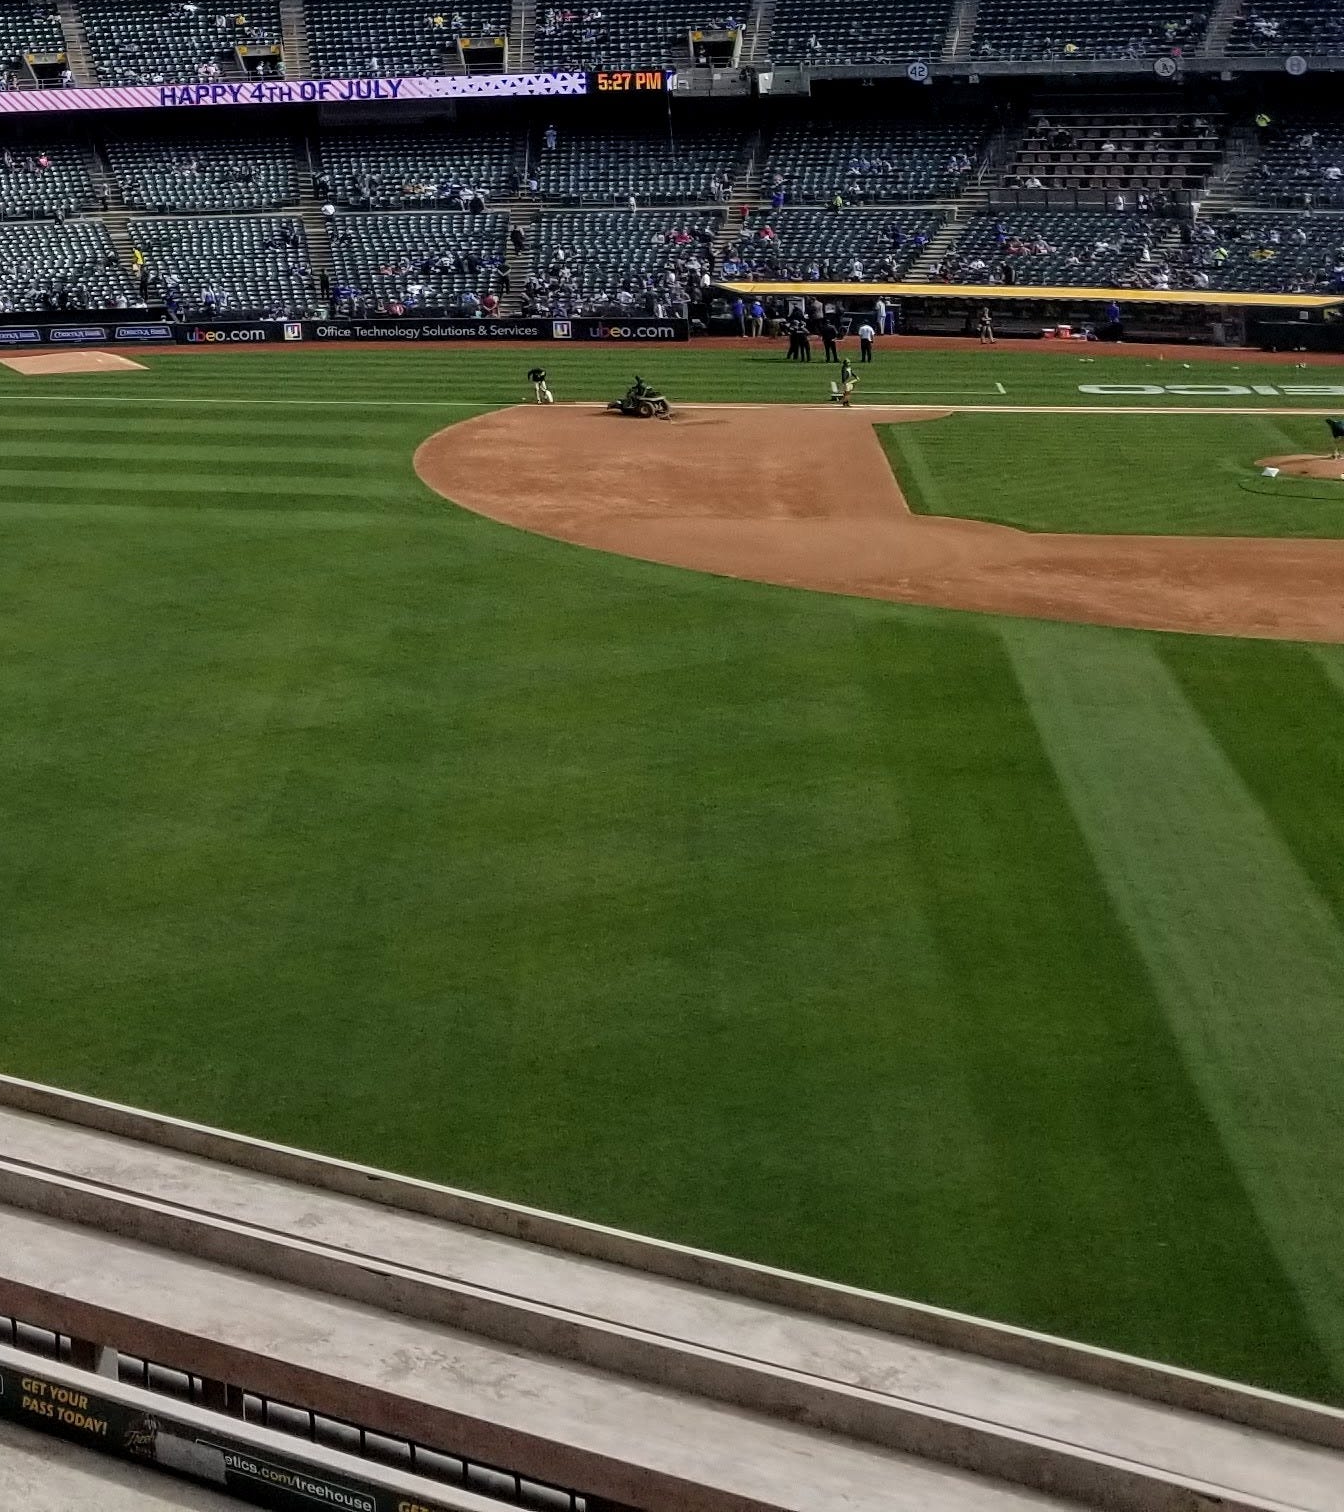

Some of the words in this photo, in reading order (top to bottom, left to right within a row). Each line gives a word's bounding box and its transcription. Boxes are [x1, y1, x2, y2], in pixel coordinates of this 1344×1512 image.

[910, 65, 925, 77] 42
[598, 73, 632, 90] 5:27
[635, 73, 661, 90] PM
[160, 84, 239, 106] HAPPY
[299, 81, 331, 100] OF
[345, 78, 403, 100] JULY
[187, 327, 265, 343] ubeo.com
[317, 326, 351, 337] Office
[355, 325, 420, 340] Technology
[423, 324, 476, 337] Solutions
[478, 324, 488, 336] &
[490, 324, 538, 336] Services
[590, 322, 675, 338] ubeo.com
[21, 1377, 47, 1396] GET
[47, 1385, 89, 1410] YOUR
[22, 1395, 54, 1417] PASS
[55, 1406, 108, 1436] TODAY!
